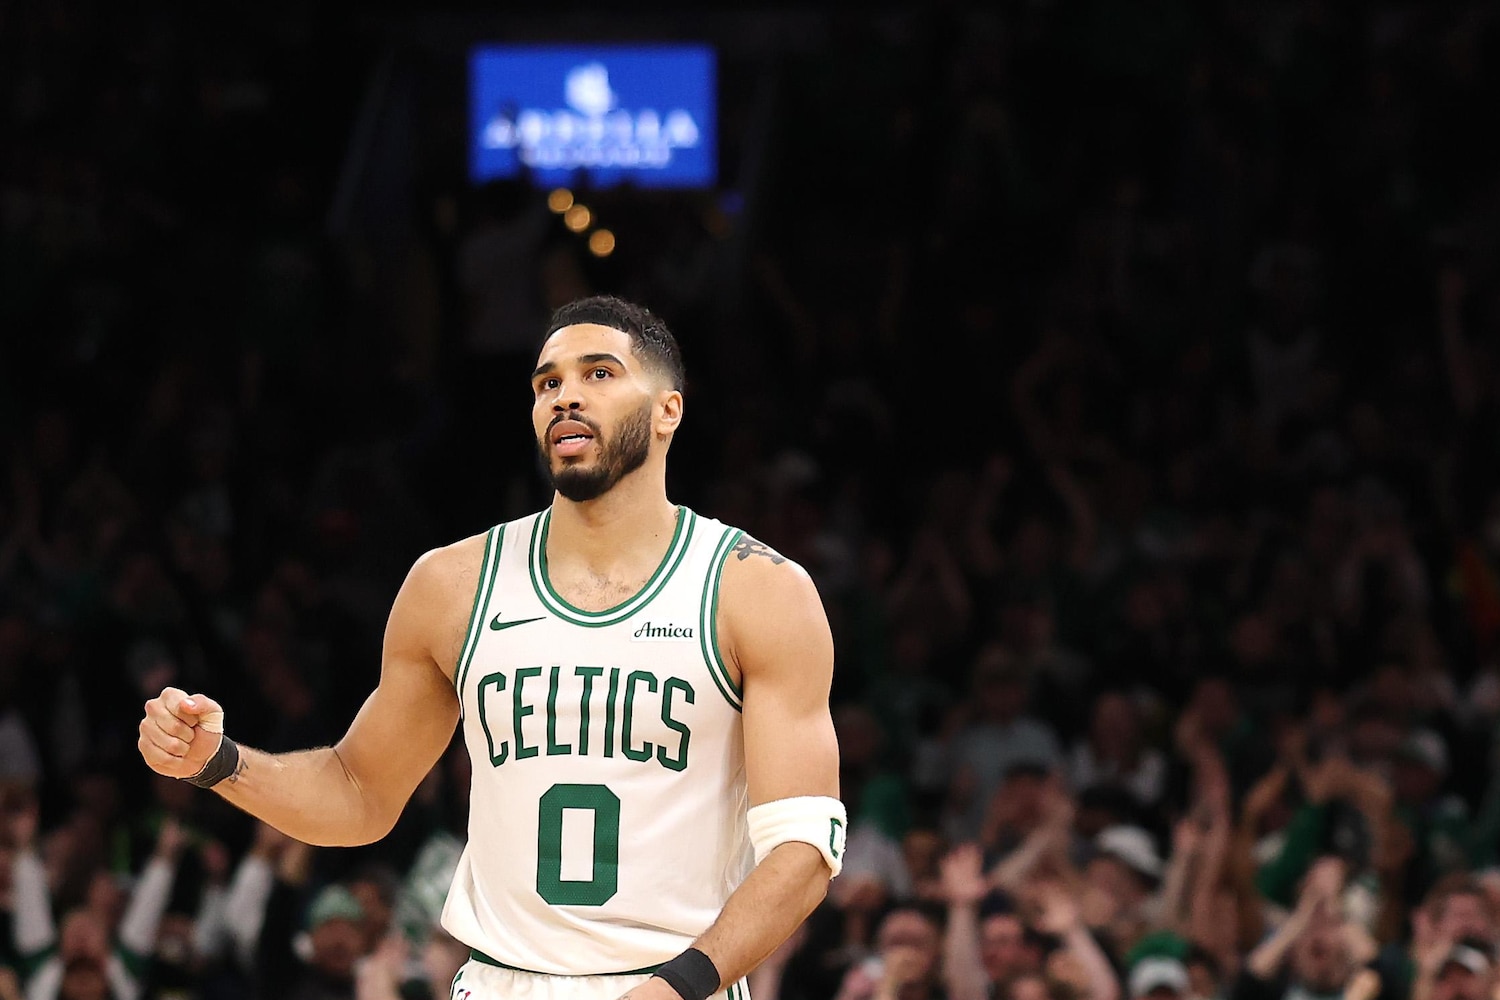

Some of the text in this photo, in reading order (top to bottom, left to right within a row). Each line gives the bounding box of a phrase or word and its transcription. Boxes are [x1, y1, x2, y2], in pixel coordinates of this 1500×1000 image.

[634, 621, 694, 639] Amica
[477, 665, 695, 773] CELTICS
[536, 783, 621, 907] 0
